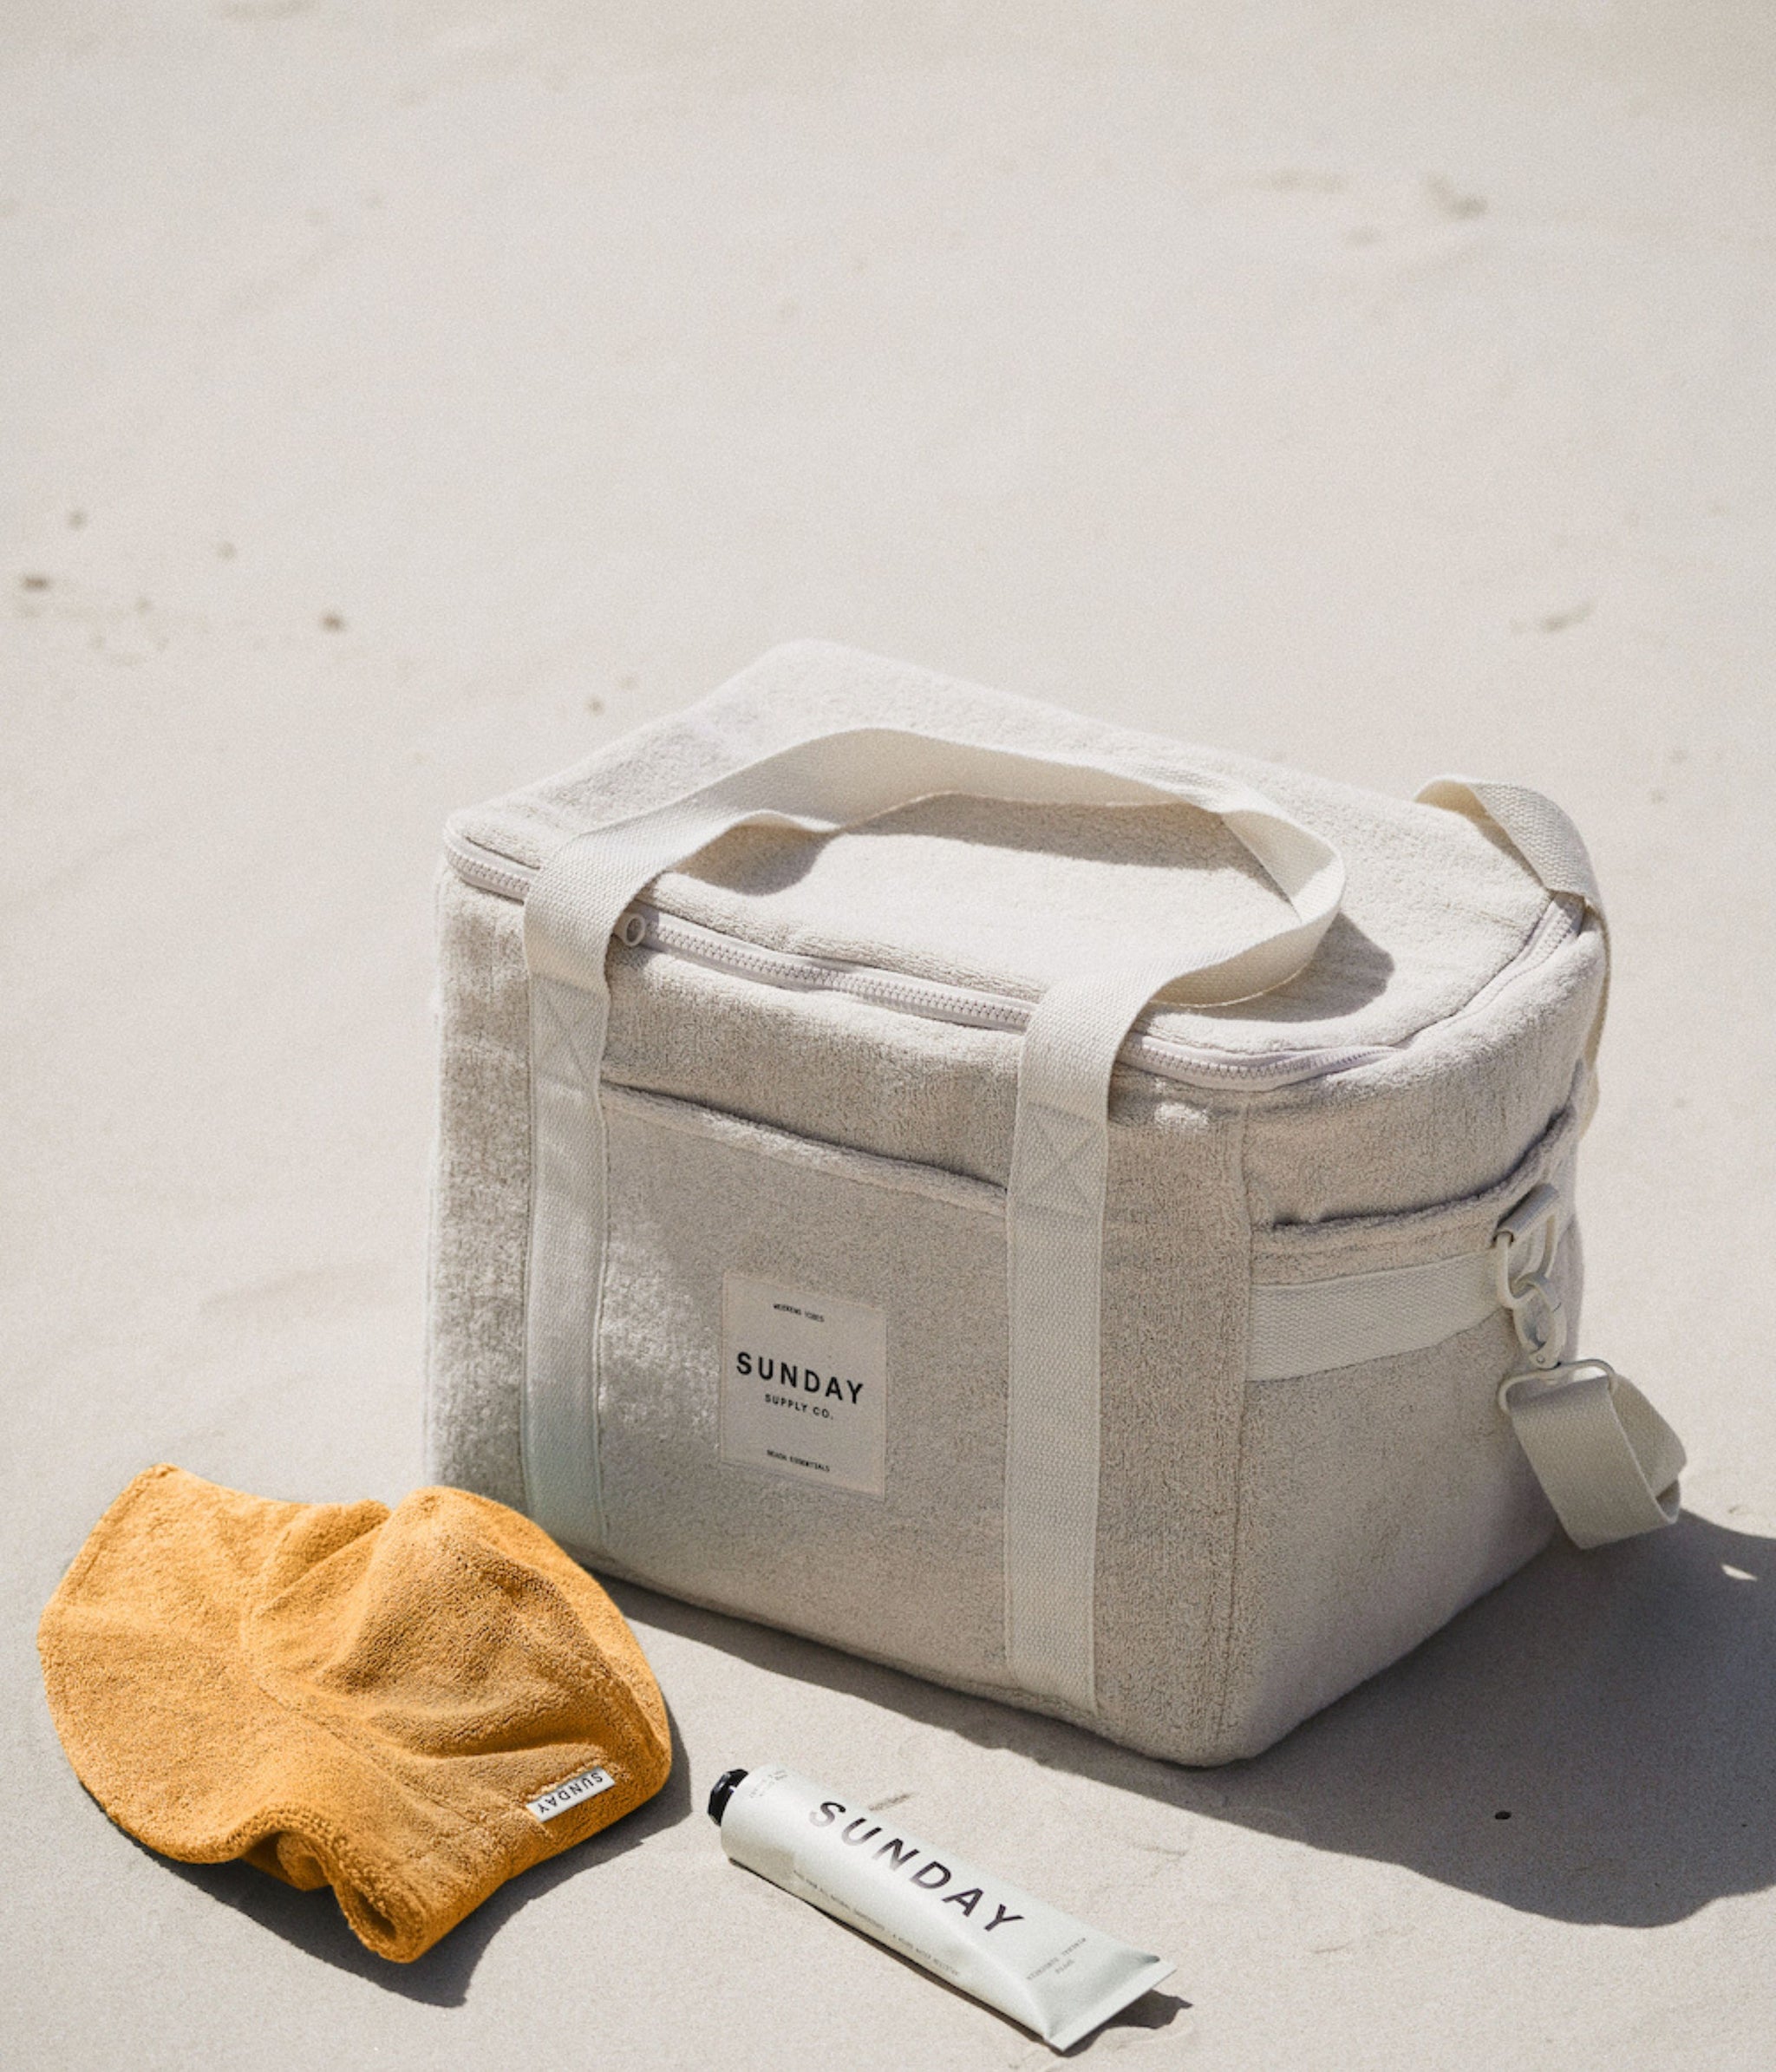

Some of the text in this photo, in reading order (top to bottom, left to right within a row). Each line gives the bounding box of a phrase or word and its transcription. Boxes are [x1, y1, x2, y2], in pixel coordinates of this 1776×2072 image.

[736, 1351, 864, 1404] SUNDAY
[765, 1394, 833, 1420] SUPPLY CO.
[538, 1772, 603, 1814] SUNDAY
[809, 1801, 1024, 1932] SUNDAY
